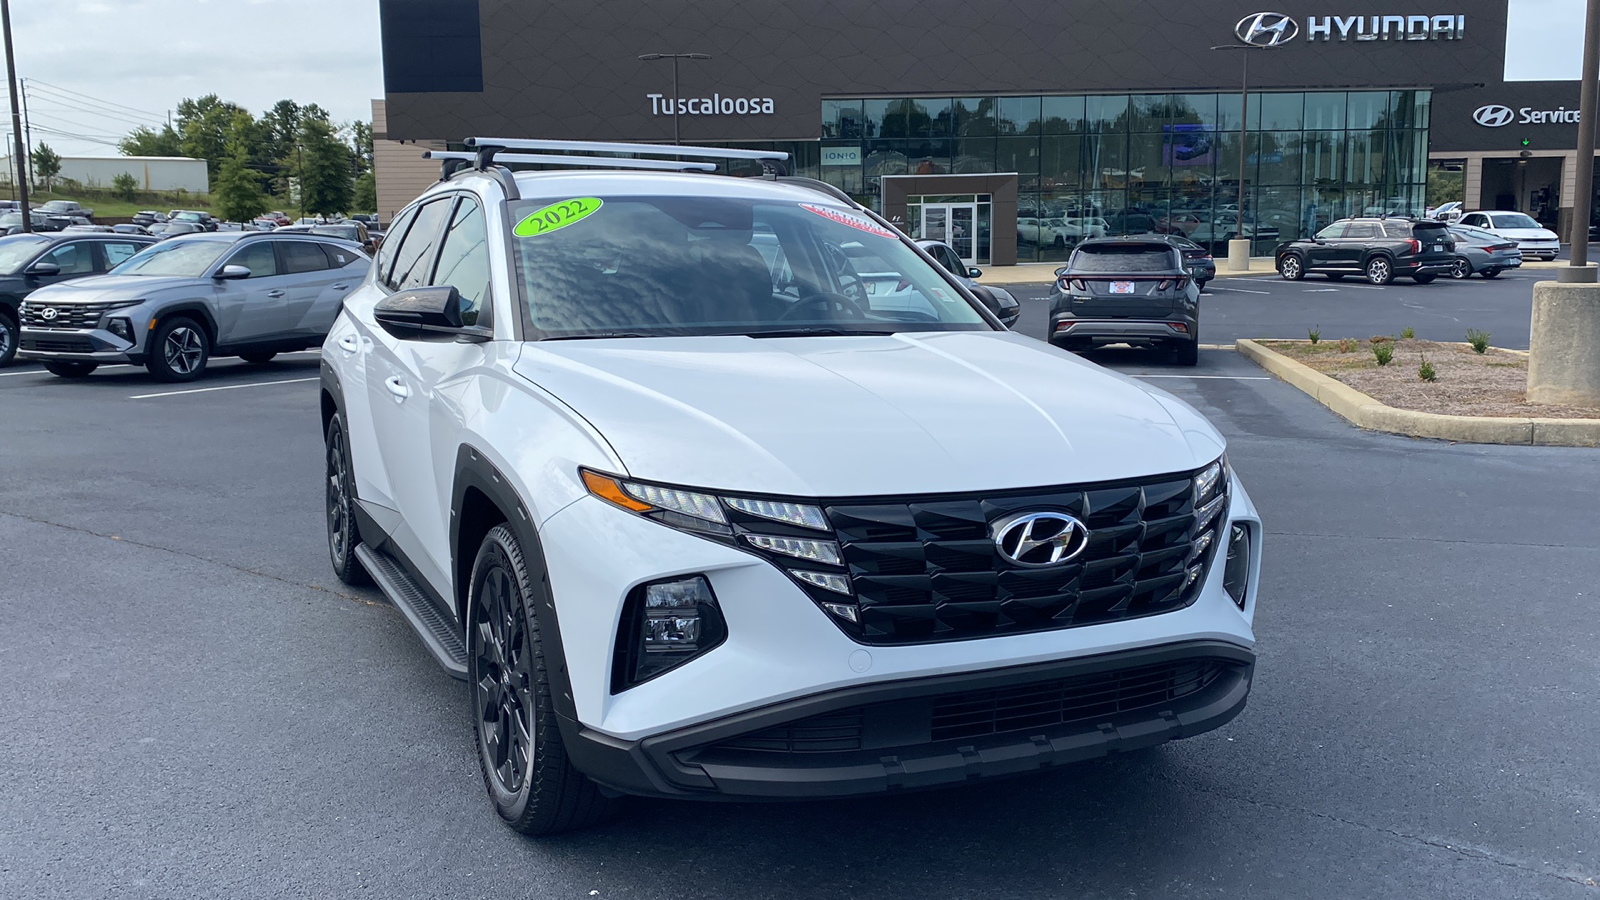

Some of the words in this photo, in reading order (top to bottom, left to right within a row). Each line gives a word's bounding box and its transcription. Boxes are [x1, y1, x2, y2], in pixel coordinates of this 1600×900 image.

[1307, 15, 1465, 41] HYUNDAI
[646, 93, 774, 115] Tuscaloosa
[1518, 106, 1581, 124] Service
[530, 201, 588, 232] 2022
